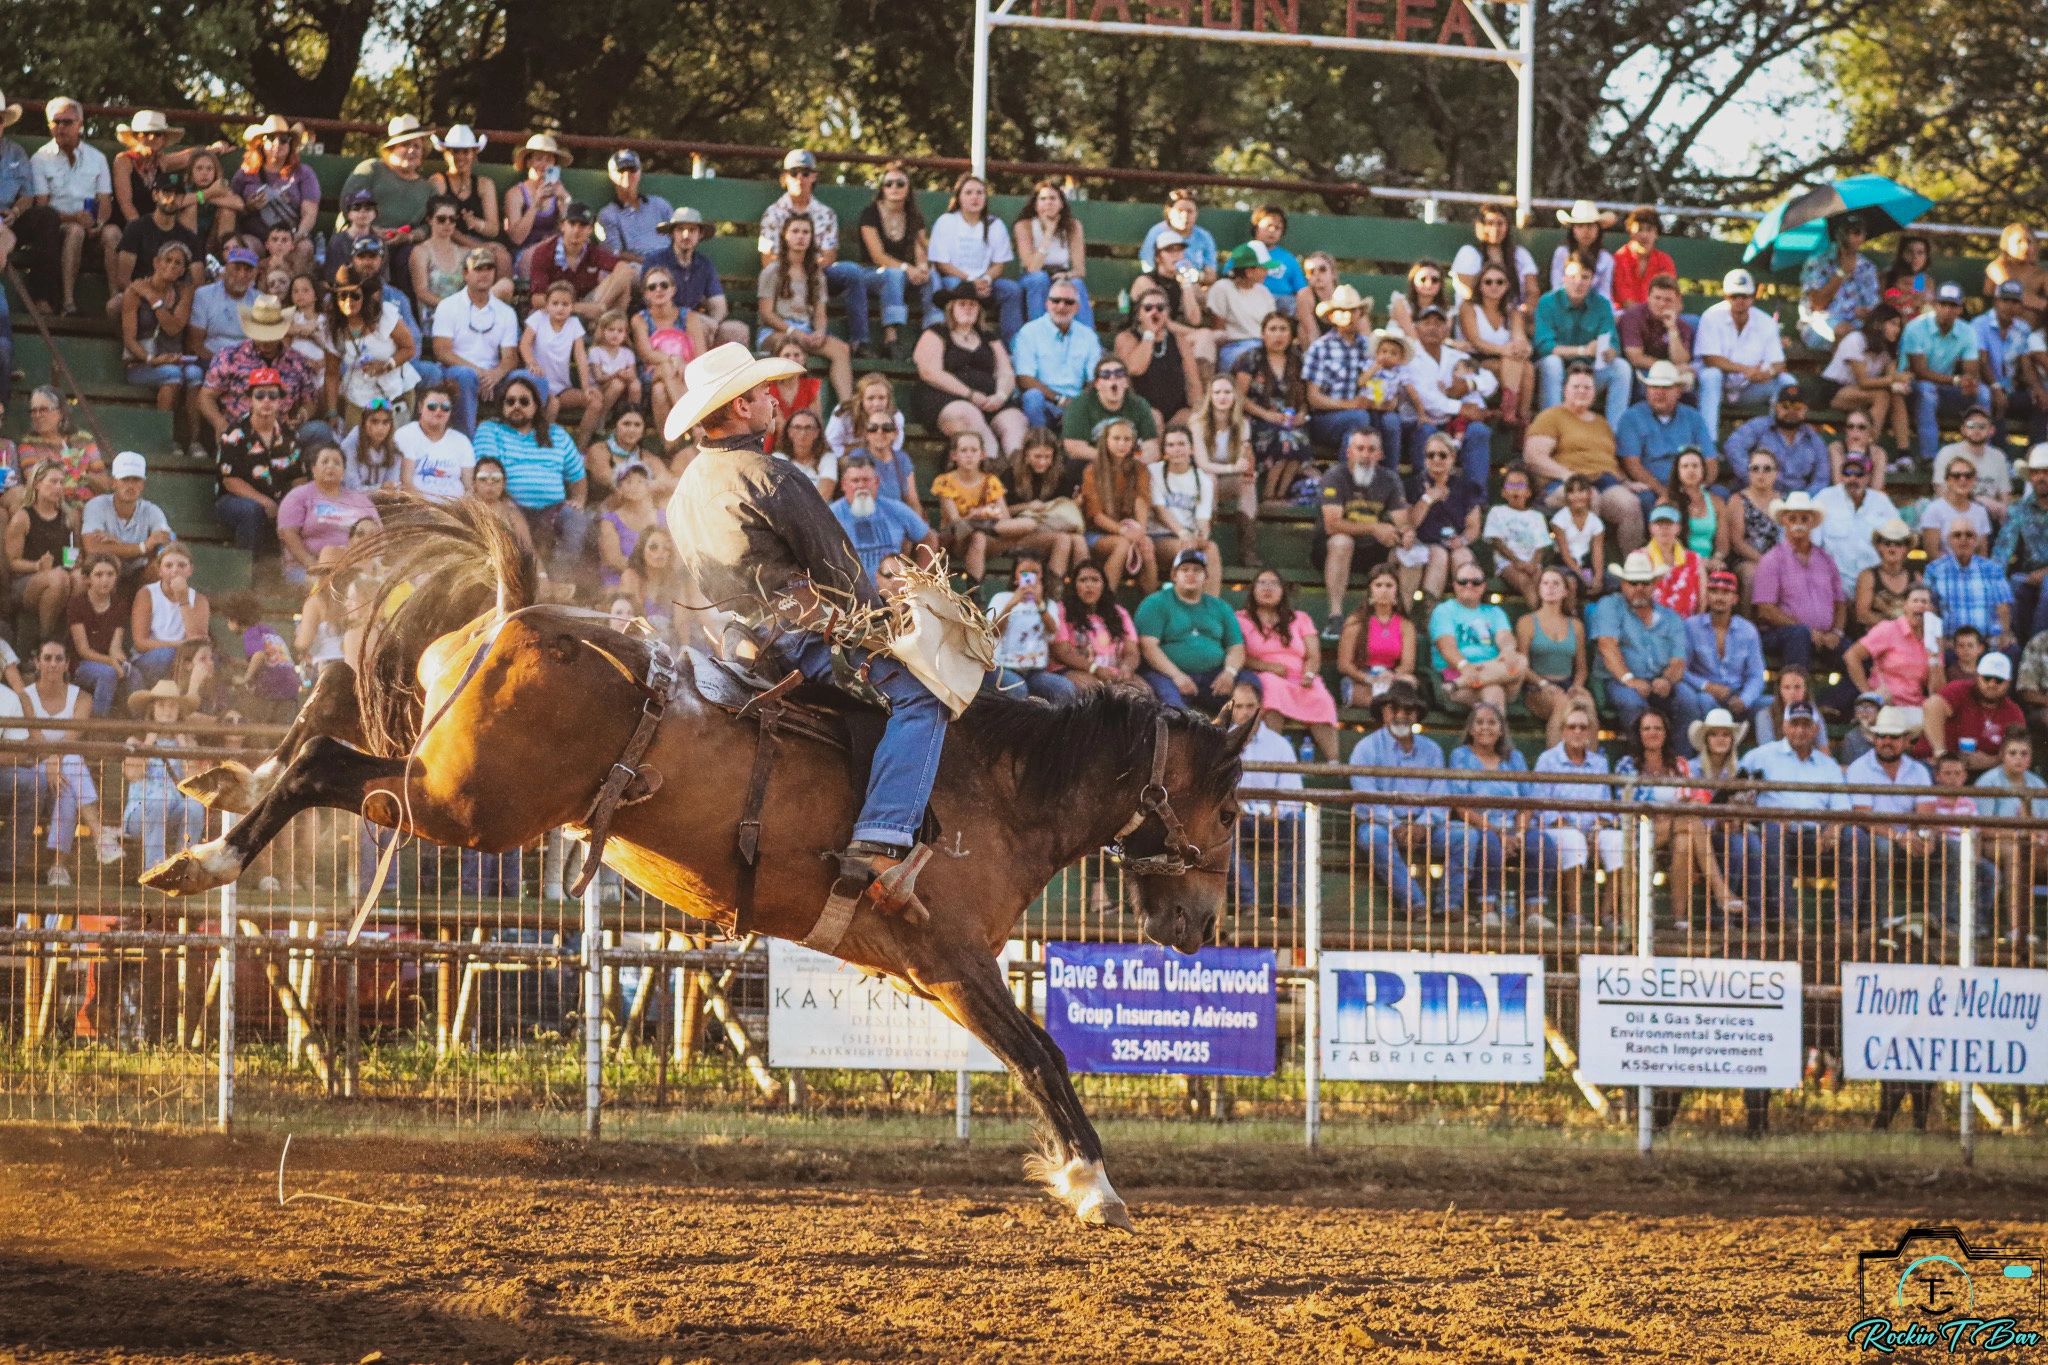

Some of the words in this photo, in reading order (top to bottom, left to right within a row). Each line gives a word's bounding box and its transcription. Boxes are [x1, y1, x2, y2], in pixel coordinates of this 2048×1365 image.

[1346, 0, 1477, 47] FFA
[1050, 957, 1097, 989] Dave
[1102, 958, 1118, 990] &
[1122, 959, 1160, 991] Kim
[1164, 960, 1270, 994] Underwood
[1596, 966, 1632, 997] K5
[1640, 967, 1785, 1001] SERVICES
[775, 987, 843, 1010] KAY
[1329, 968, 1534, 1047] RDI
[1855, 974, 1920, 1016] Thom
[1928, 976, 1947, 1017] &
[1953, 977, 2042, 1031] Melany
[1067, 1002, 1113, 1030] Group
[1116, 1003, 1190, 1027] Insurance
[1192, 1005, 1258, 1029] Advisors
[1625, 1012, 1645, 1024] Oil
[1649, 1013, 1659, 1025] &
[1664, 1013, 1690, 1026] Gas
[1695, 1013, 1755, 1027] Services
[1609, 1026, 1710, 1041] Environmental
[1713, 1029, 1775, 1043] Services
[1111, 1038, 1210, 1063] 325-205-0235
[1331, 1049, 1533, 1065] FABRICATORS
[1625, 1042, 1669, 1055] Ranch
[1672, 1043, 1763, 1058] Improvement
[1863, 1036, 2028, 1075] CANFIELD
